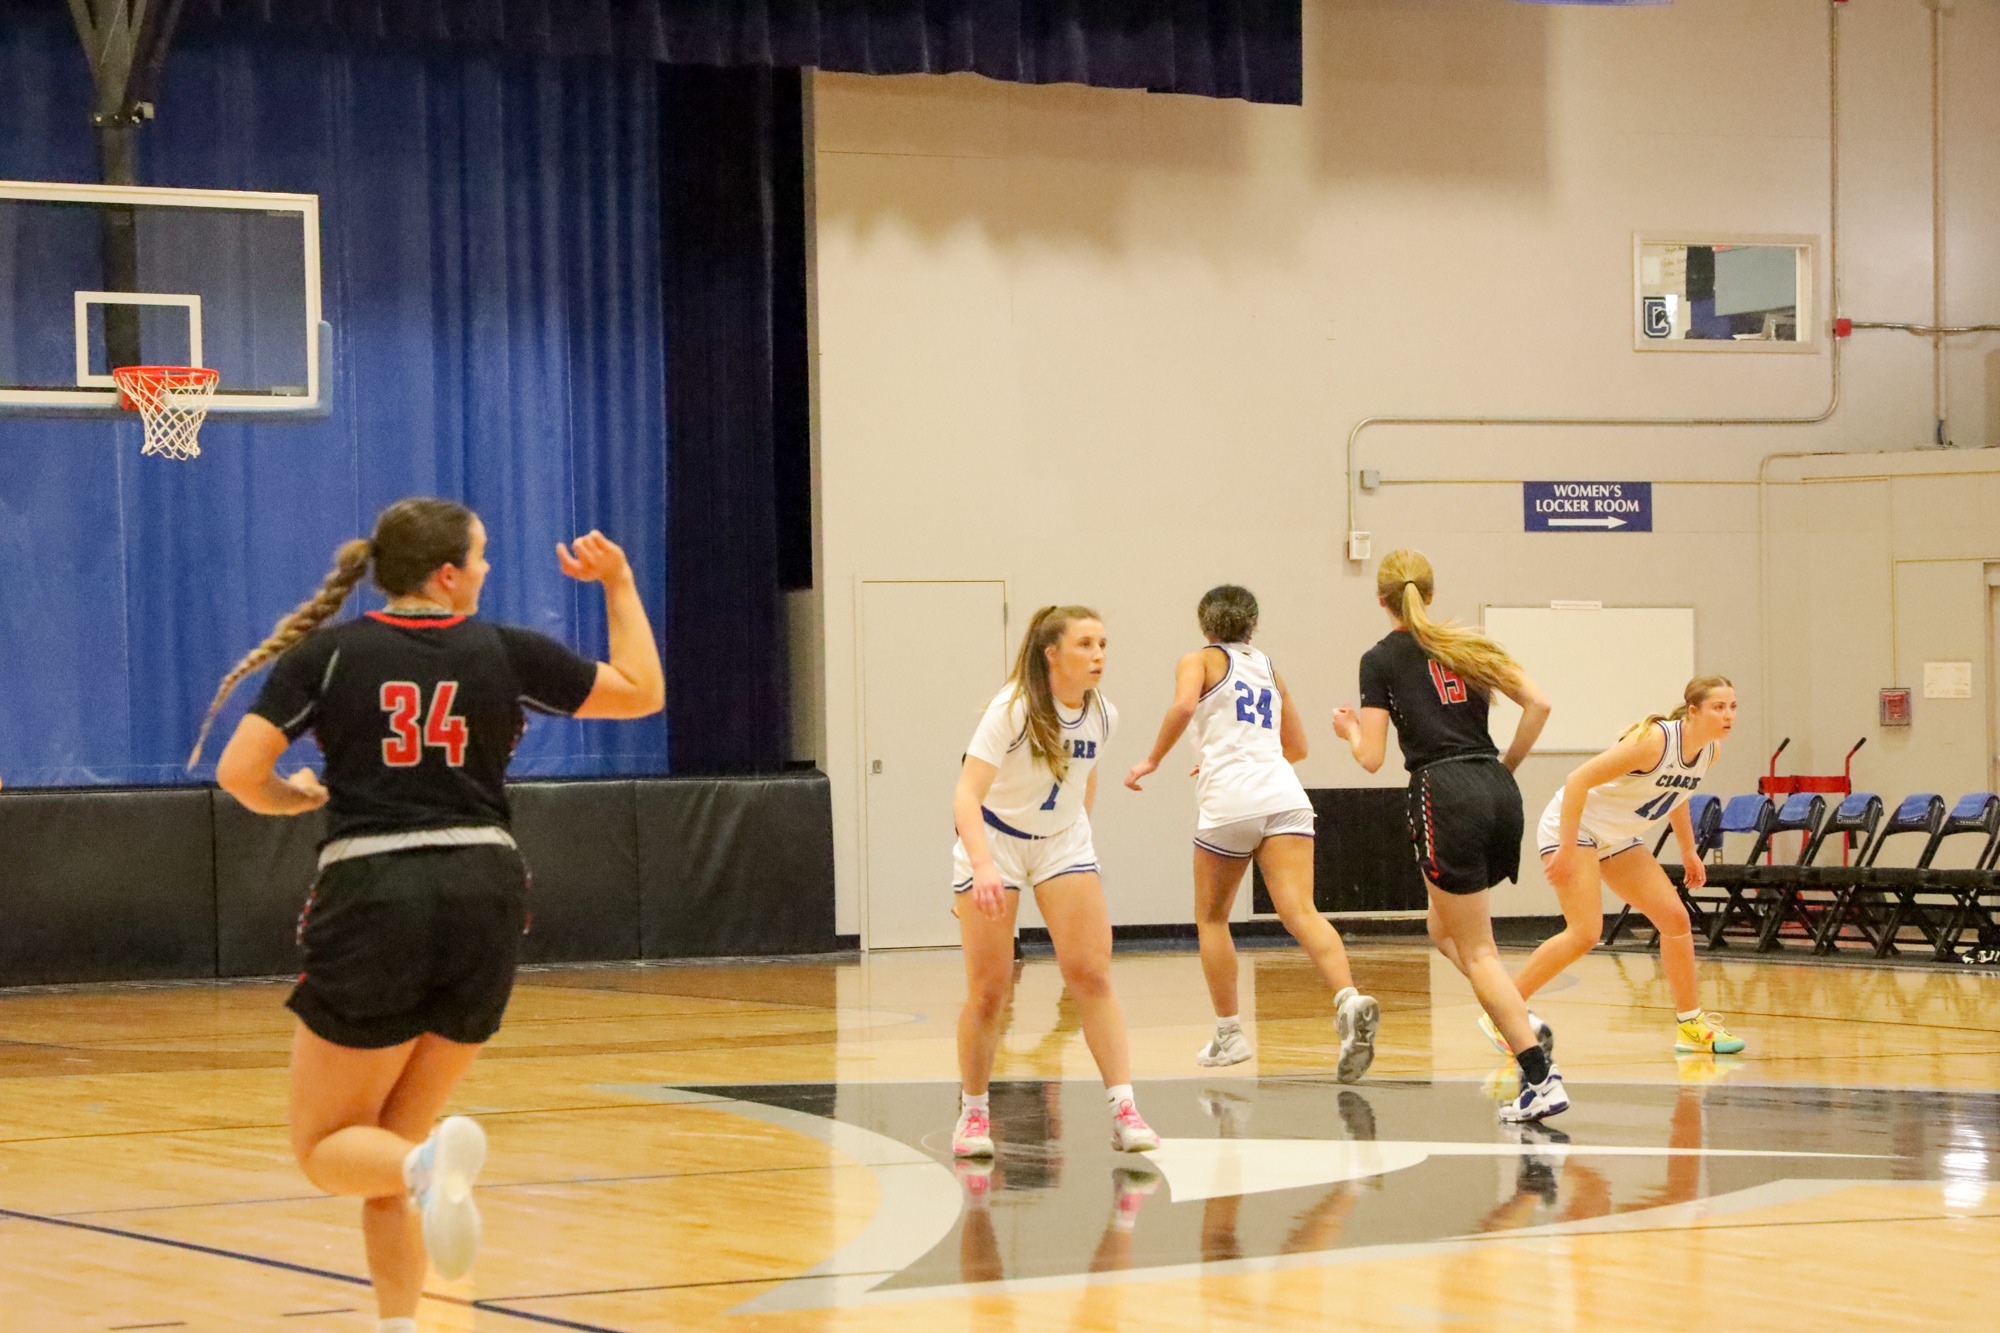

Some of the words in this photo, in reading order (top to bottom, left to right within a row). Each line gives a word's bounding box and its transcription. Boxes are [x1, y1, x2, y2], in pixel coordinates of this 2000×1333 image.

[1535, 499, 1590, 512] LOCKER
[1594, 499, 1640, 512] ROOM
[1553, 484, 1622, 498] WOMEN'S
[1428, 659, 1467, 704] 15
[380, 681, 469, 767] 34
[1235, 680, 1272, 729] 24
